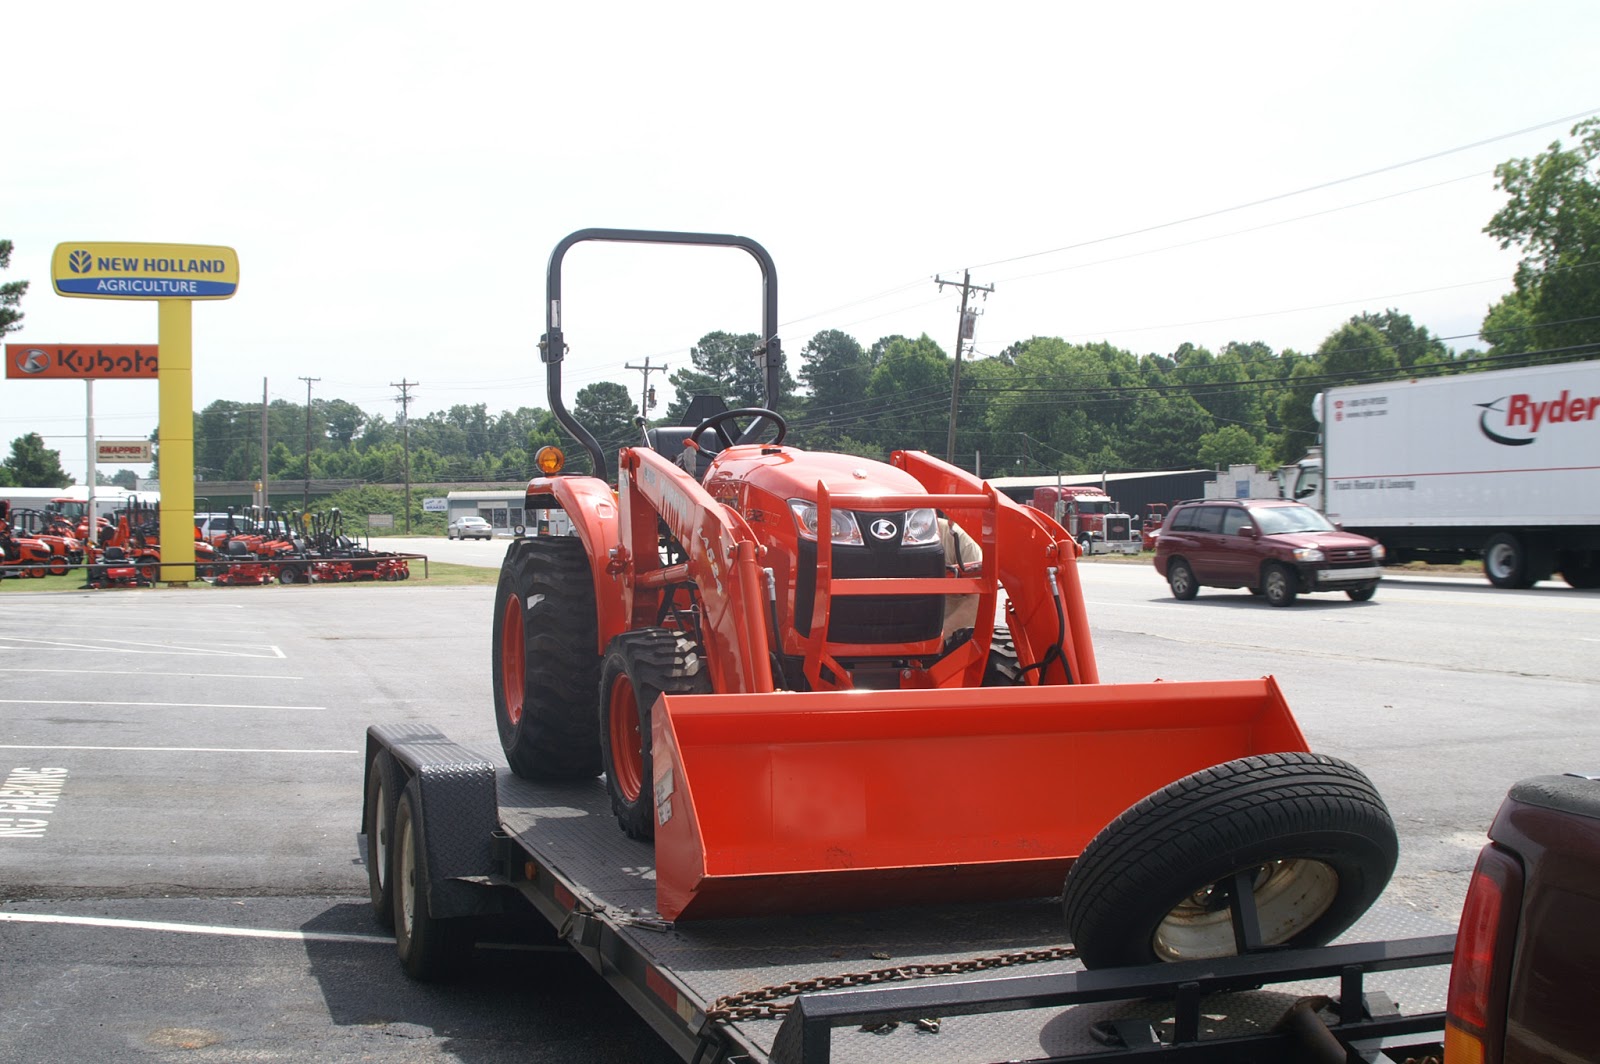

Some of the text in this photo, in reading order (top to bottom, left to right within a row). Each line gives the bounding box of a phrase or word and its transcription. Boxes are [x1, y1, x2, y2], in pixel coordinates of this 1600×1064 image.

[97, 257, 225, 273] NEW HOLLAND
[97, 279, 197, 293] AGRICULTURE
[57, 349, 158, 373] Kubota
[1505, 389, 1600, 433] Ryder
[99, 446, 142, 454] SNAPPER
